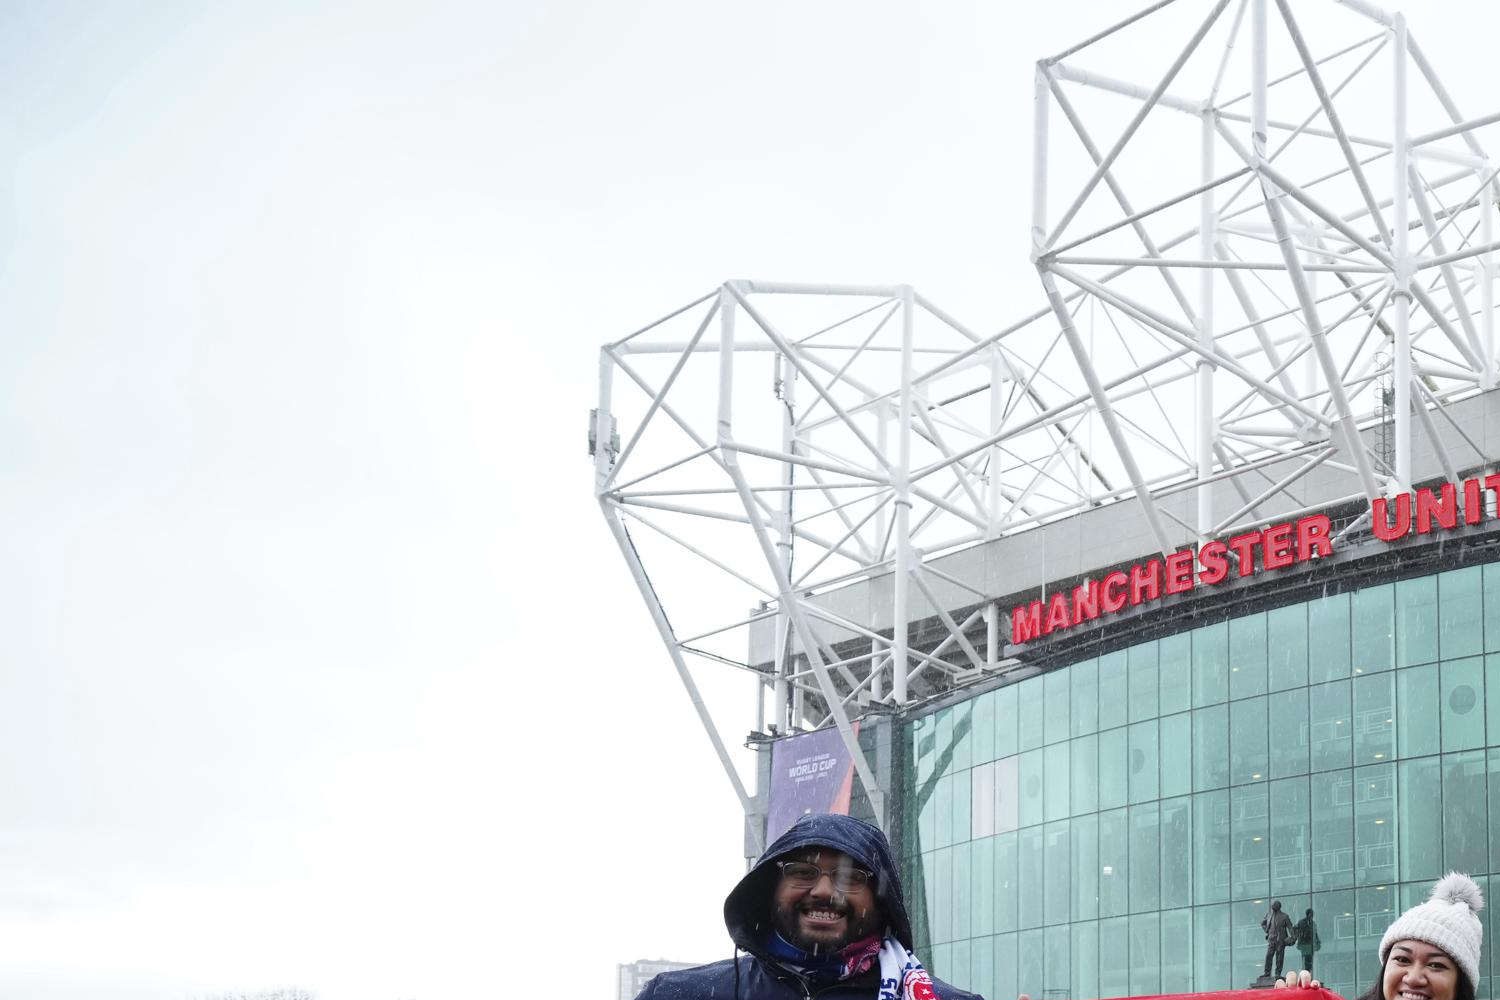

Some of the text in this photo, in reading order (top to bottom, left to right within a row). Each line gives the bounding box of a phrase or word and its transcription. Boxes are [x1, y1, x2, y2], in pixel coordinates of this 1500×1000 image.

[1012, 513, 1333, 645] MANCHESTER
[789, 762, 818, 778] WORLD
[819, 758, 837, 771] CUP
